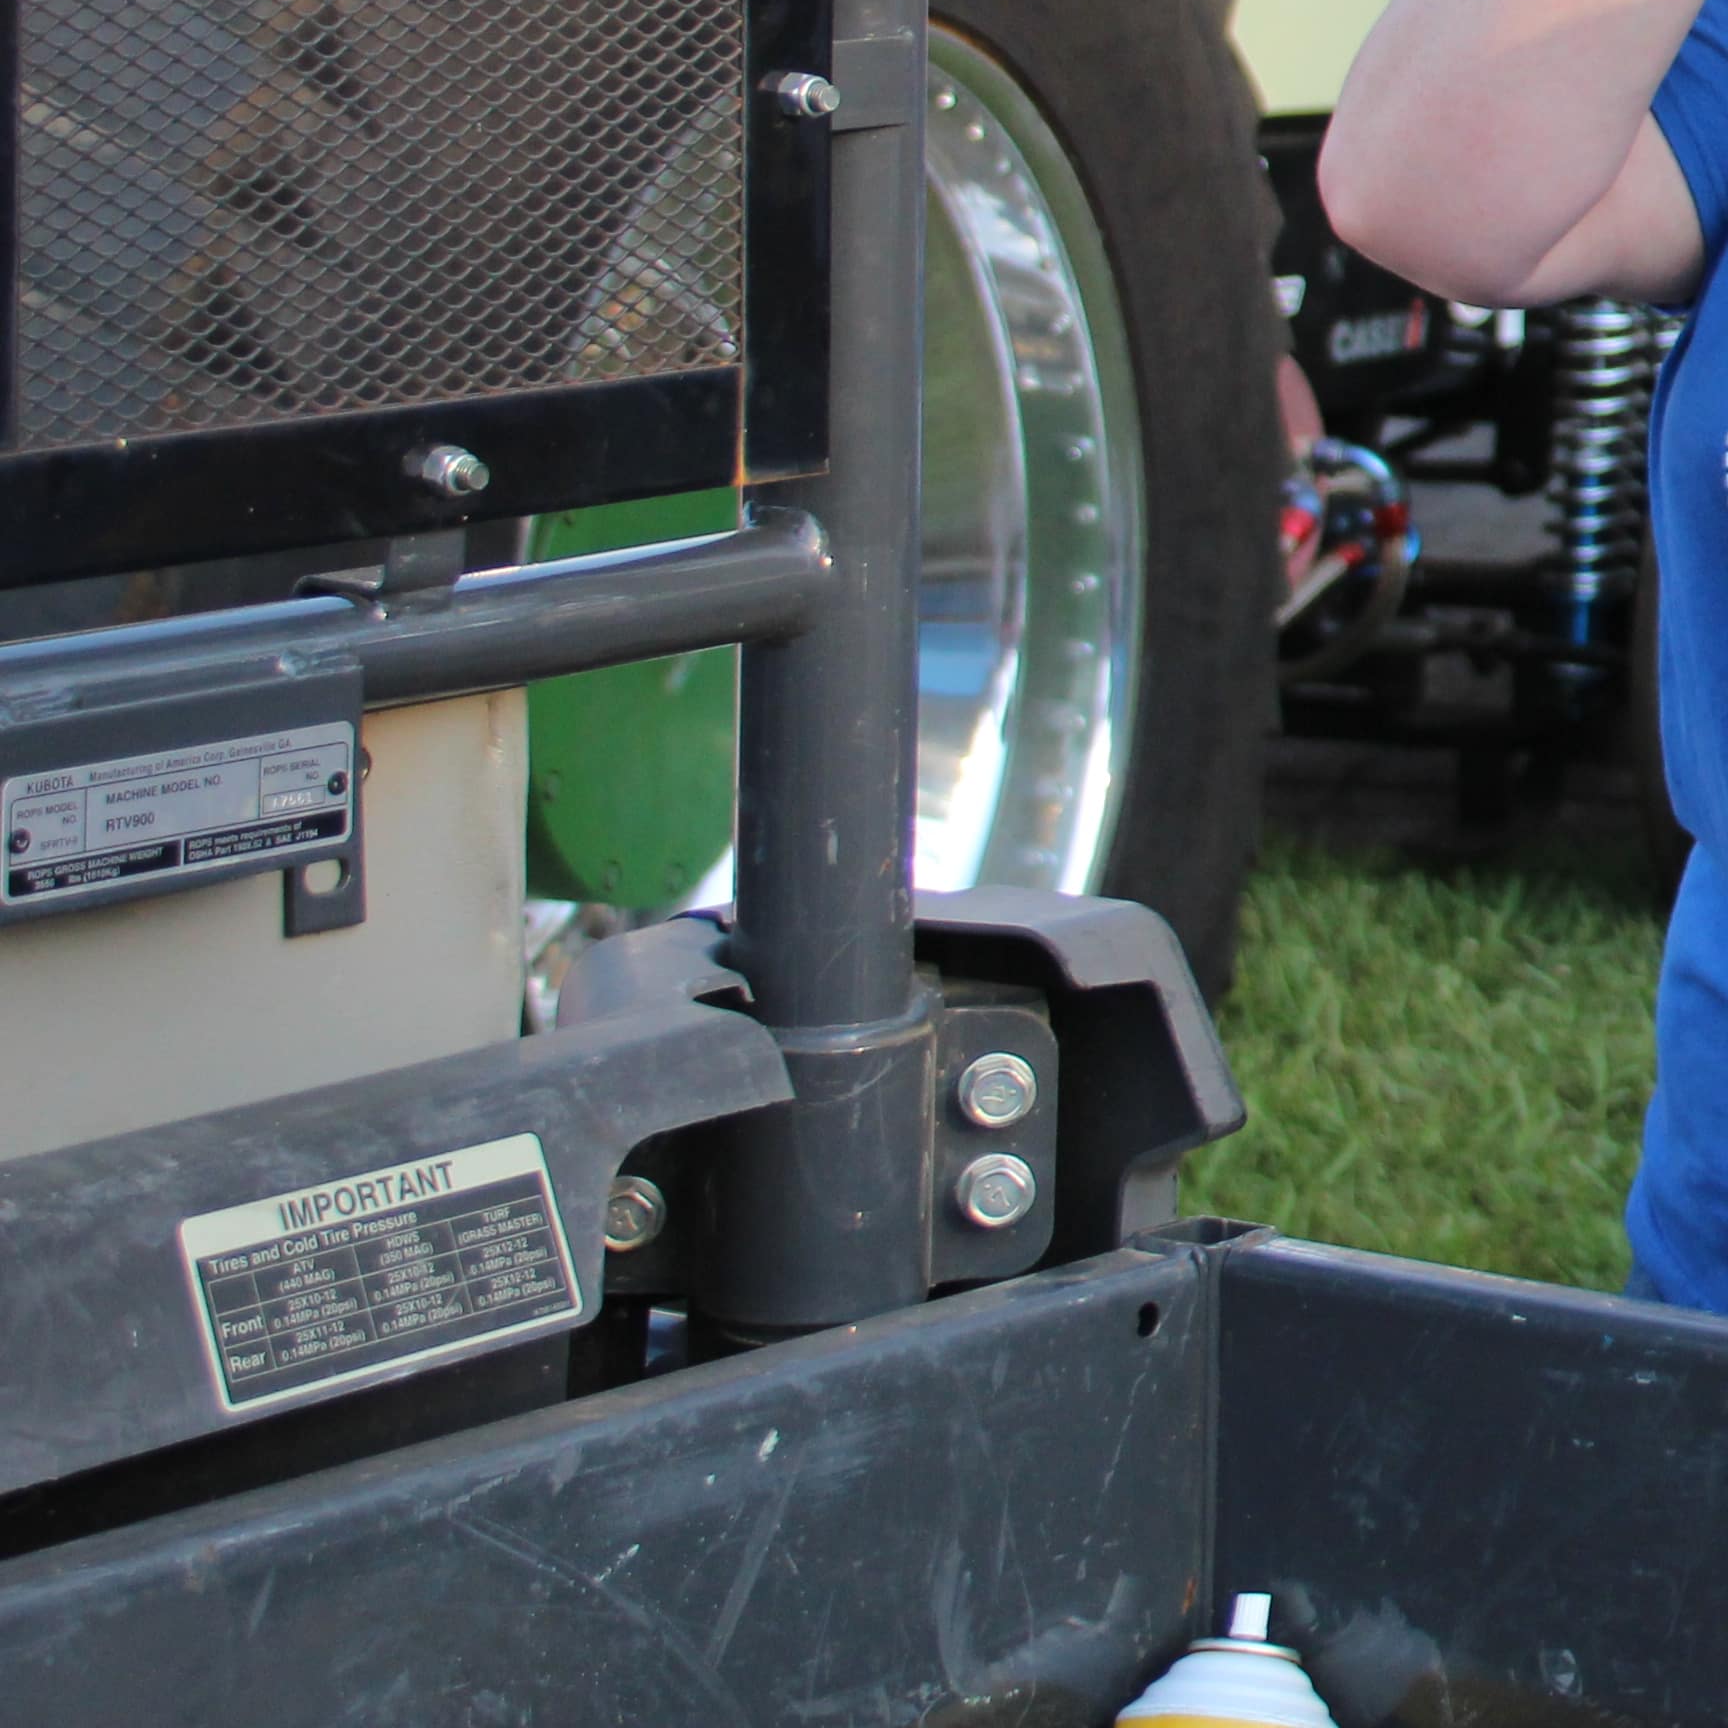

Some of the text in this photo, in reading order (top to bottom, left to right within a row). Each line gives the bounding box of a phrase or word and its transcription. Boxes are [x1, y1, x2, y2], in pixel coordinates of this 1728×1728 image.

[27, 775, 74, 794] KUBOTA
[166, 754, 200, 770] America
[106, 785, 157, 804] MACHINE
[161, 778, 199, 795] MODEL
[106, 812, 156, 832] RTV900
[54, 862, 86, 875] GROSS
[279, 1161, 453, 1231] IMPORTANT
[483, 1207, 511, 1223] TURF
[458, 1213, 543, 1245] (GRASS MASTER)
[209, 1211, 417, 1276] Tires and Cold Tire Pressure
[386, 1232, 420, 1249] HDWS
[404, 1242, 434, 1260] MAG)
[293, 1259, 315, 1274] ATV
[305, 1269, 335, 1288] MAG)
[221, 1314, 264, 1340] Front
[230, 1349, 266, 1374] Rear
